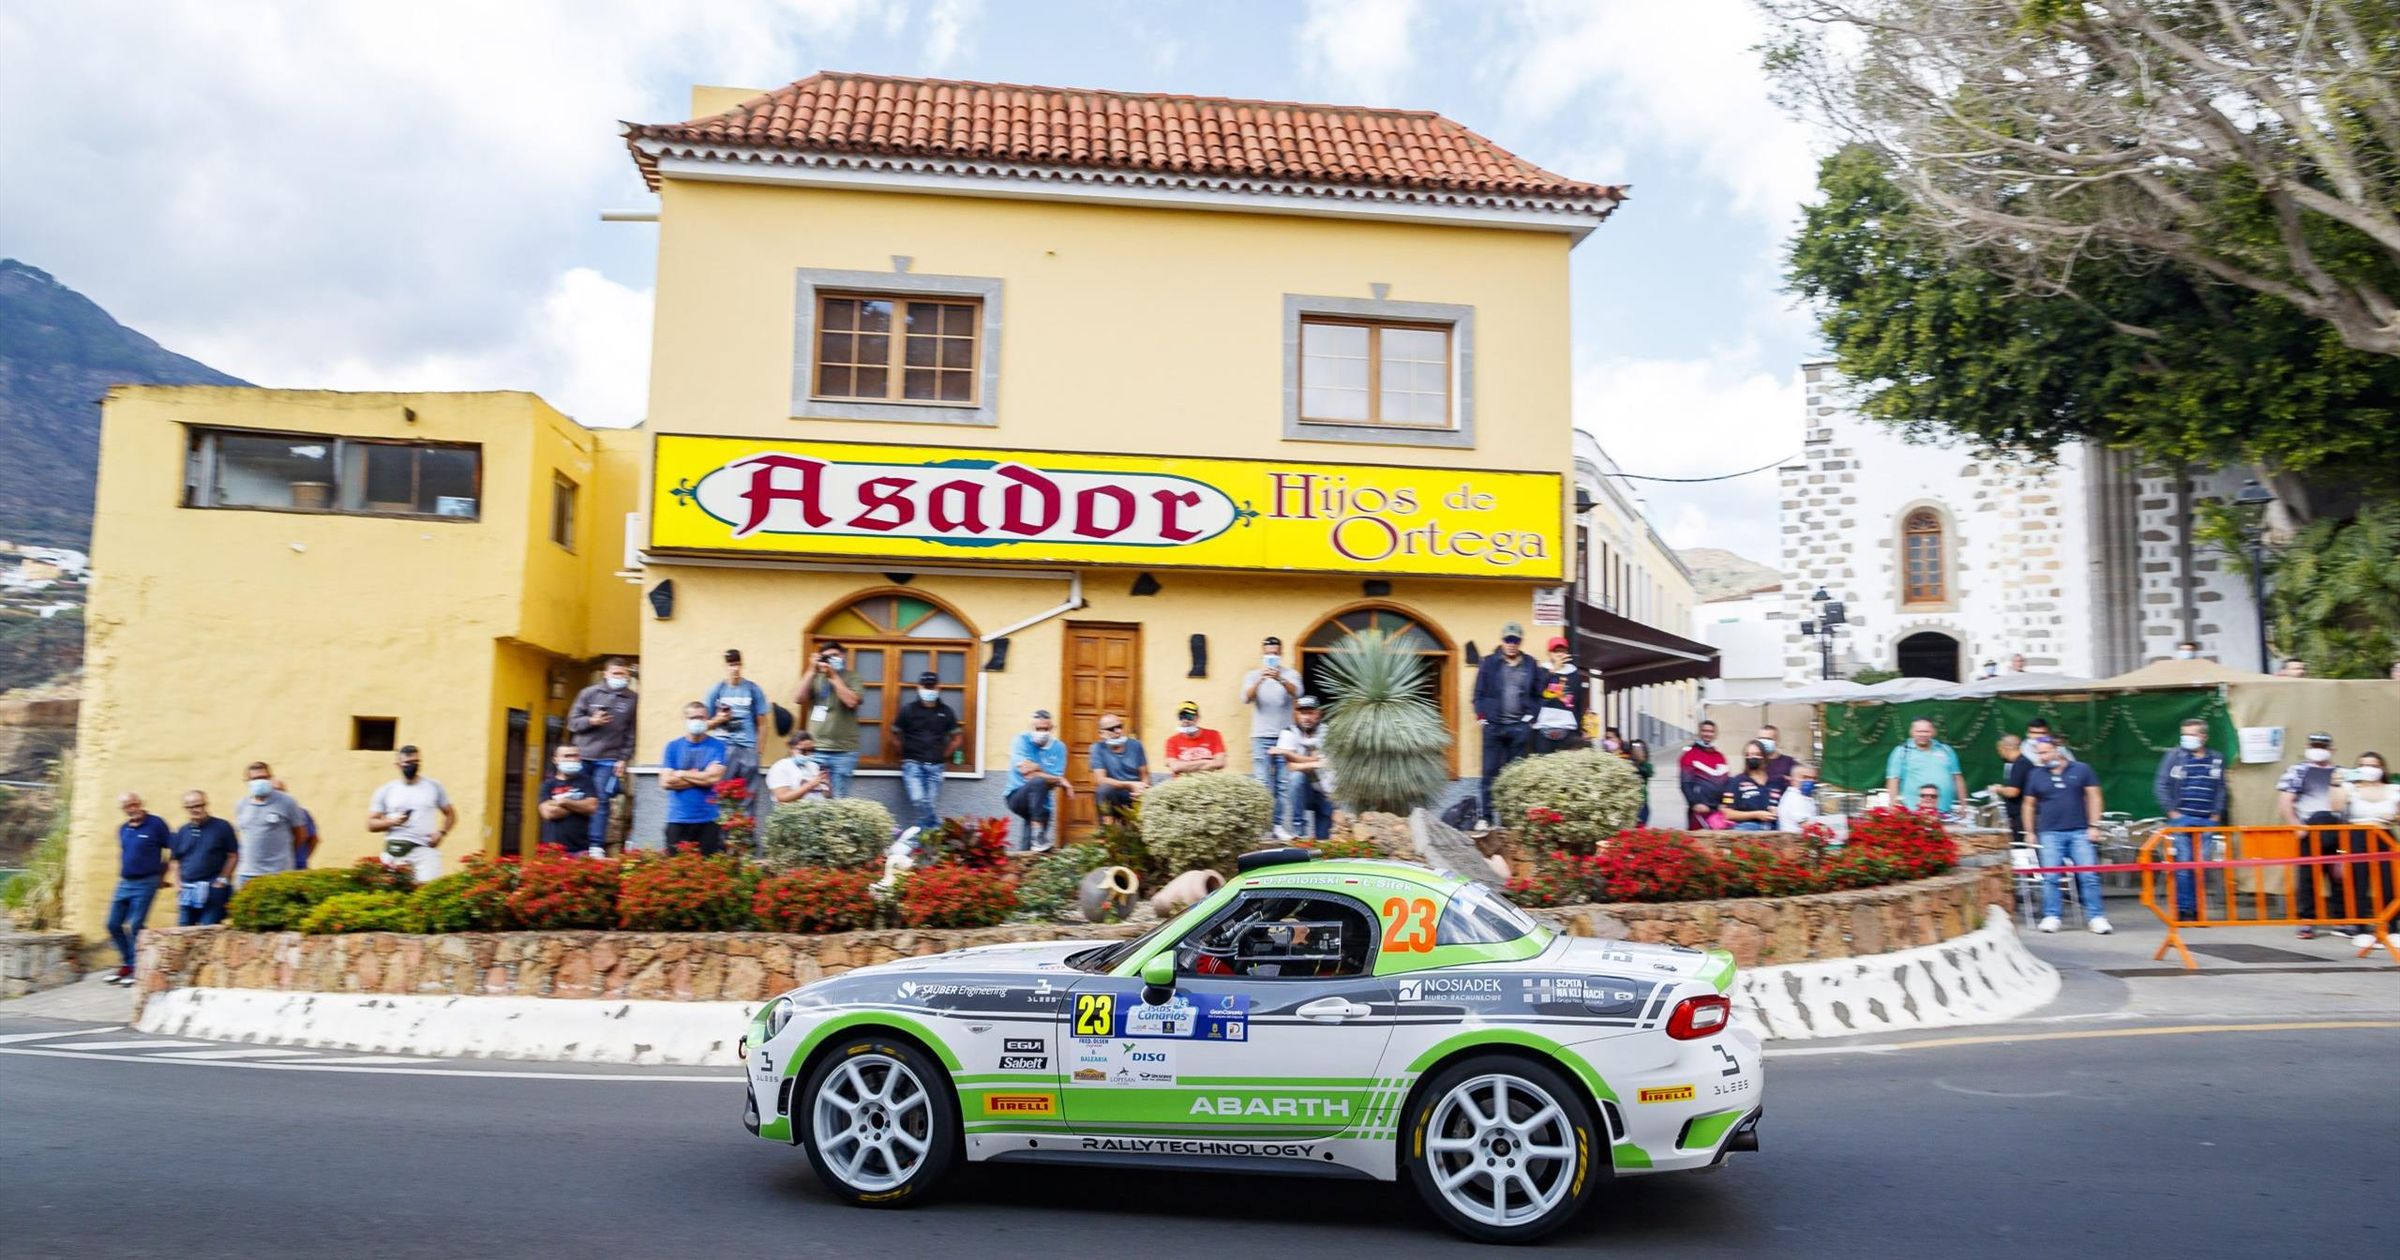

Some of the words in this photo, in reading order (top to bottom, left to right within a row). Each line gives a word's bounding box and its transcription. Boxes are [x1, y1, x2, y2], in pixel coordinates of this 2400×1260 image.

[731, 455, 1203, 541] Asador
[1268, 473, 1418, 518] Hijos
[1444, 485, 1494, 510] de
[1333, 516, 1547, 565] Ortega
[1382, 897, 1437, 953] 23
[922, 985, 958, 995] SAUBER
[958, 985, 1008, 997] Engineering
[1424, 979, 1502, 992] NOSIADEK
[1556, 988, 1567, 998] NA
[1077, 995, 1111, 1035] 23
[1138, 1010, 1187, 1021] Canarias
[1003, 1057, 1044, 1069] Sabelt
[1641, 1087, 1692, 1102] PIRELLI
[991, 1097, 1048, 1110] PIRELLI
[1190, 1097, 1349, 1117] ABARTH
[1083, 1137, 1314, 1156] RALLYTECHNOLOGY
